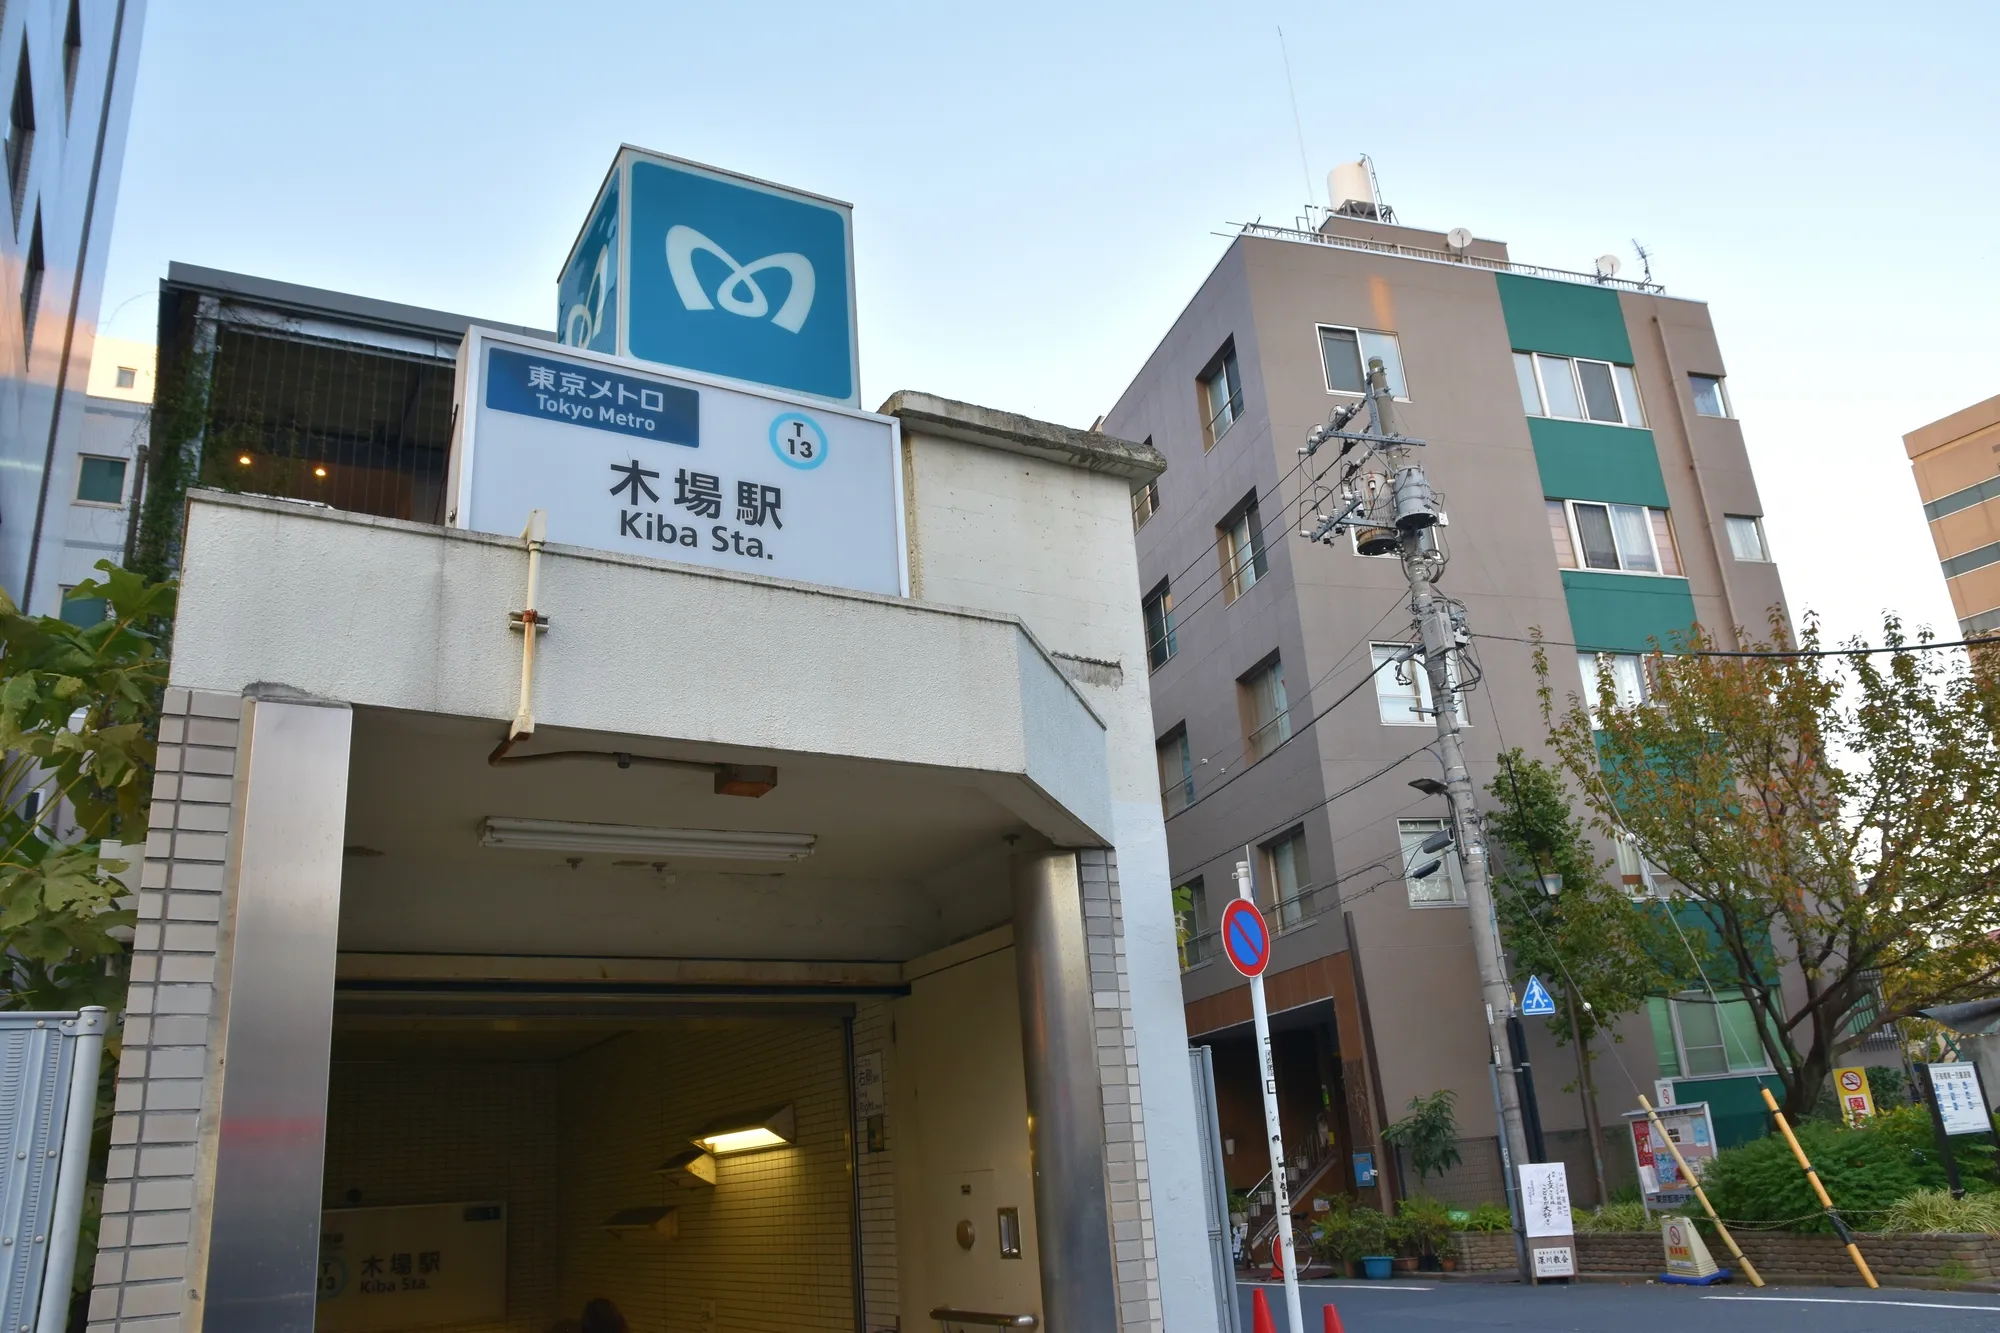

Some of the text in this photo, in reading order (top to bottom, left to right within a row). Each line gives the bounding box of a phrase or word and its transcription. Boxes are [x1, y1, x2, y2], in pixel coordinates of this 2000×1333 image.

[528, 365, 664, 413] 東京メトロ
[535, 393, 656, 431] Tokyo Metro
[793, 421, 804, 438] T
[787, 438, 813, 459] 13
[609, 459, 783, 530] 木場駅
[620, 509, 774, 560] Kiba Sta.
[361, 1250, 441, 1277] 木場駅
[360, 1277, 431, 1294] Kiba Sta.
